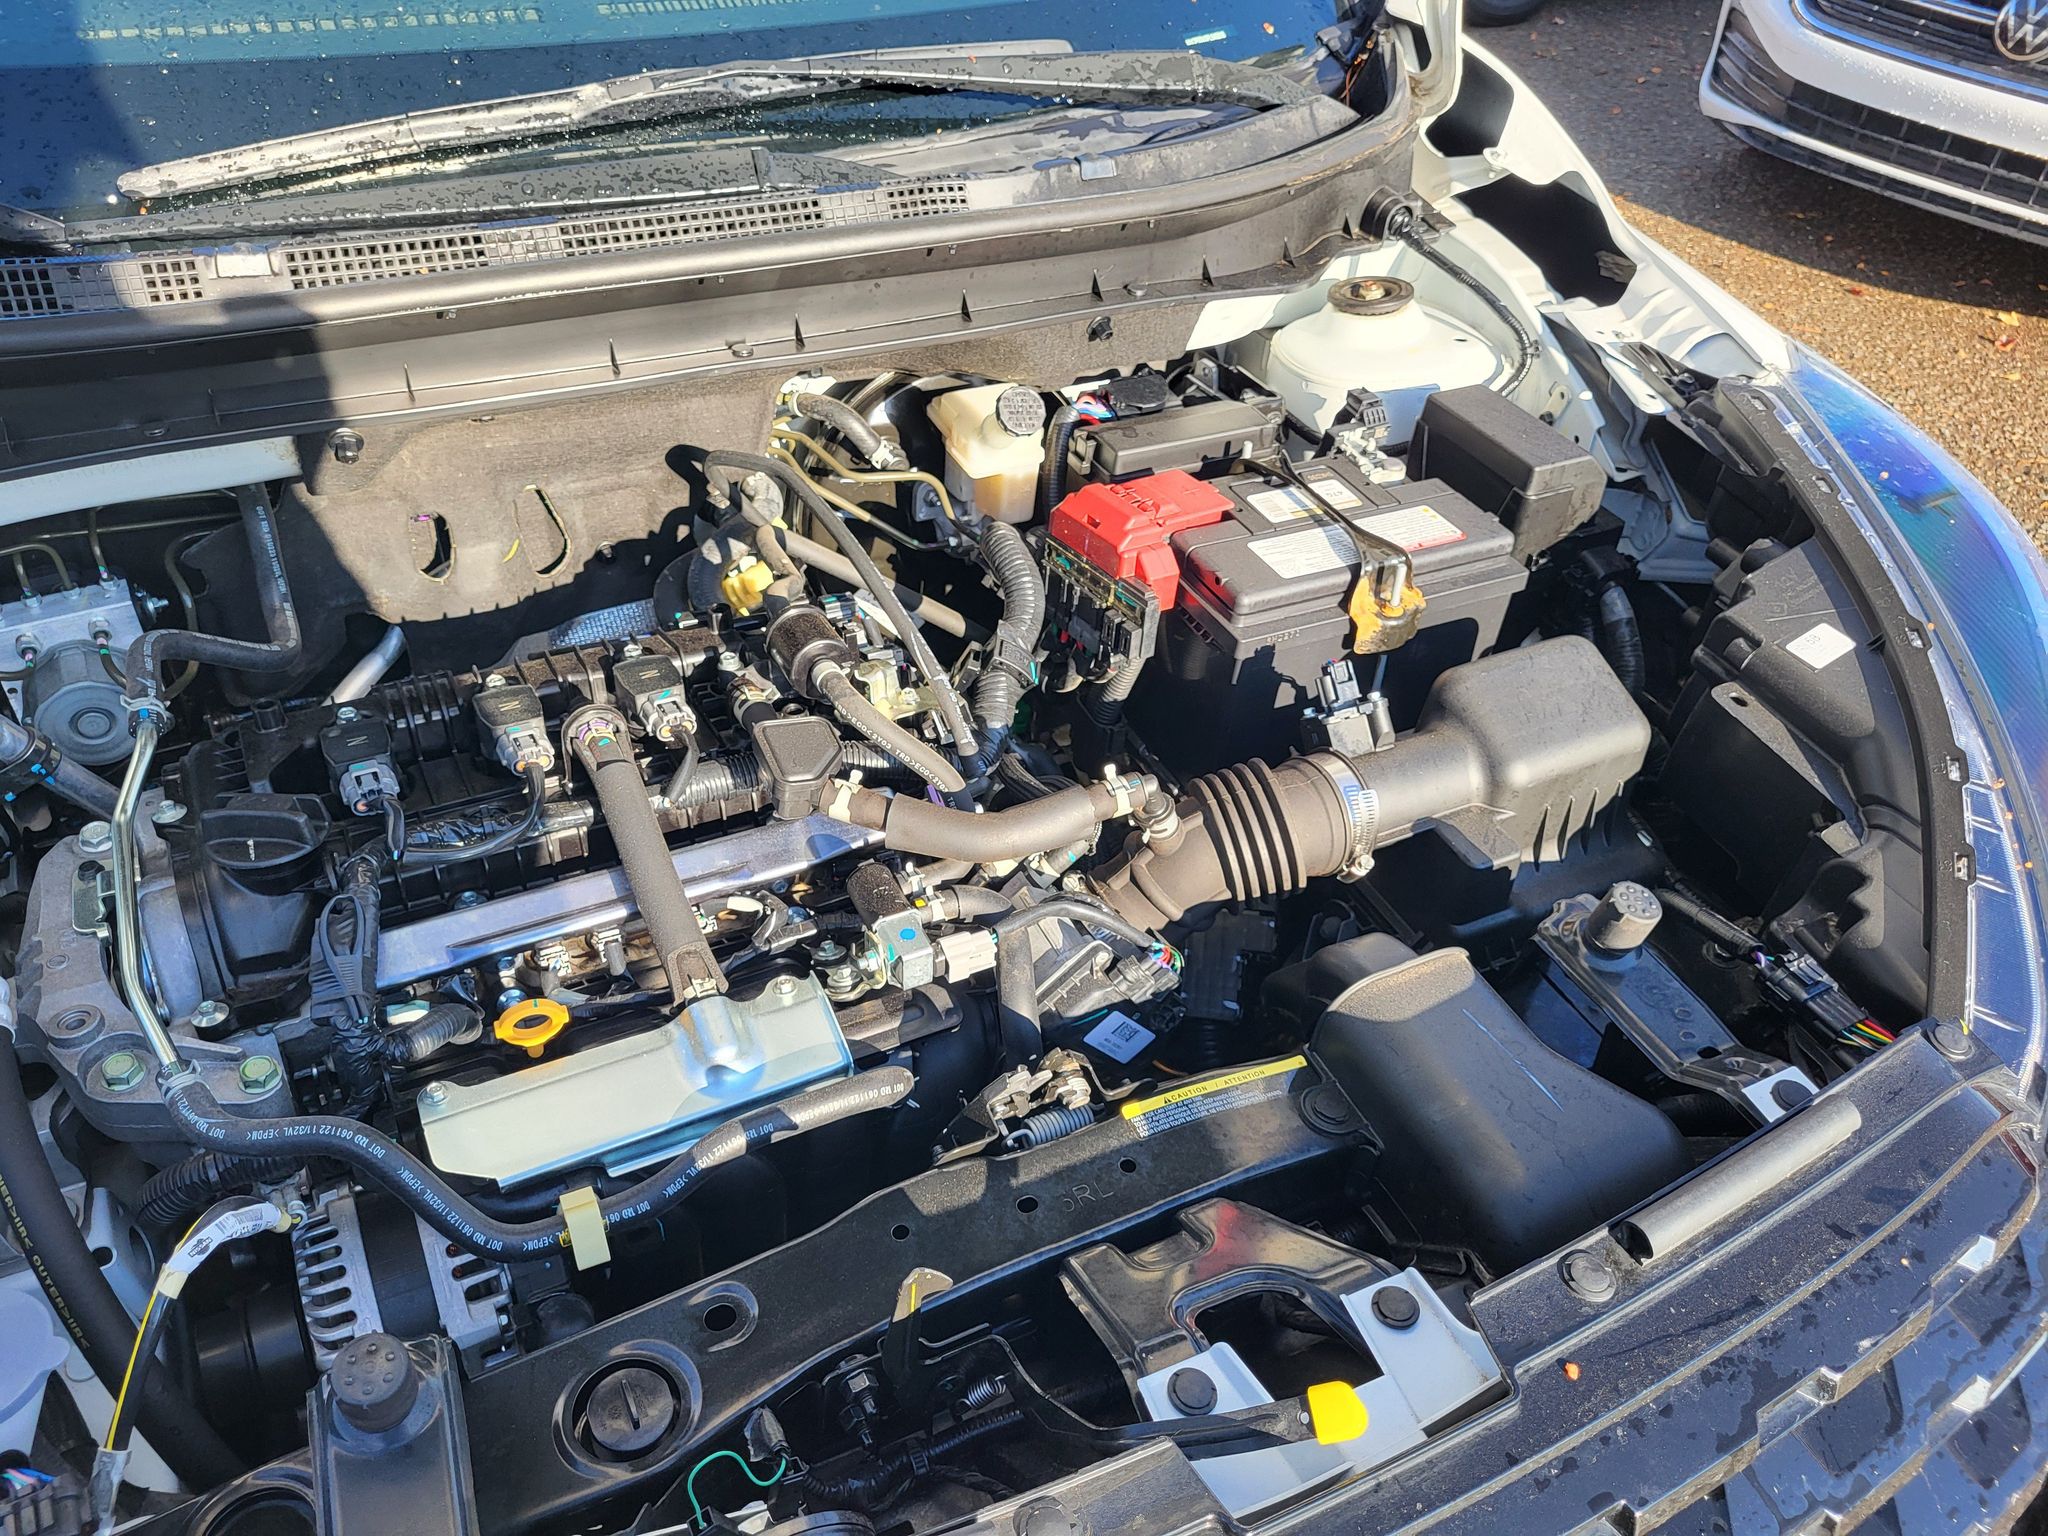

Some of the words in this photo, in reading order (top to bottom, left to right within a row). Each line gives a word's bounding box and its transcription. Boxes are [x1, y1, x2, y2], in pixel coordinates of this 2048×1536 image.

[1171, 1086, 1208, 1100] CAUTION
[1224, 1070, 1265, 1086] ATTENTION
[208, 1127, 226, 1139] DOT
[319, 1125, 353, 1139] 061122
[760, 1123, 774, 1136] DOT
[369, 1143, 386, 1159] DOT
[637, 1201, 651, 1214] DOT
[446, 1212, 474, 1237] 061122
[486, 1241, 503, 1251] DOT
